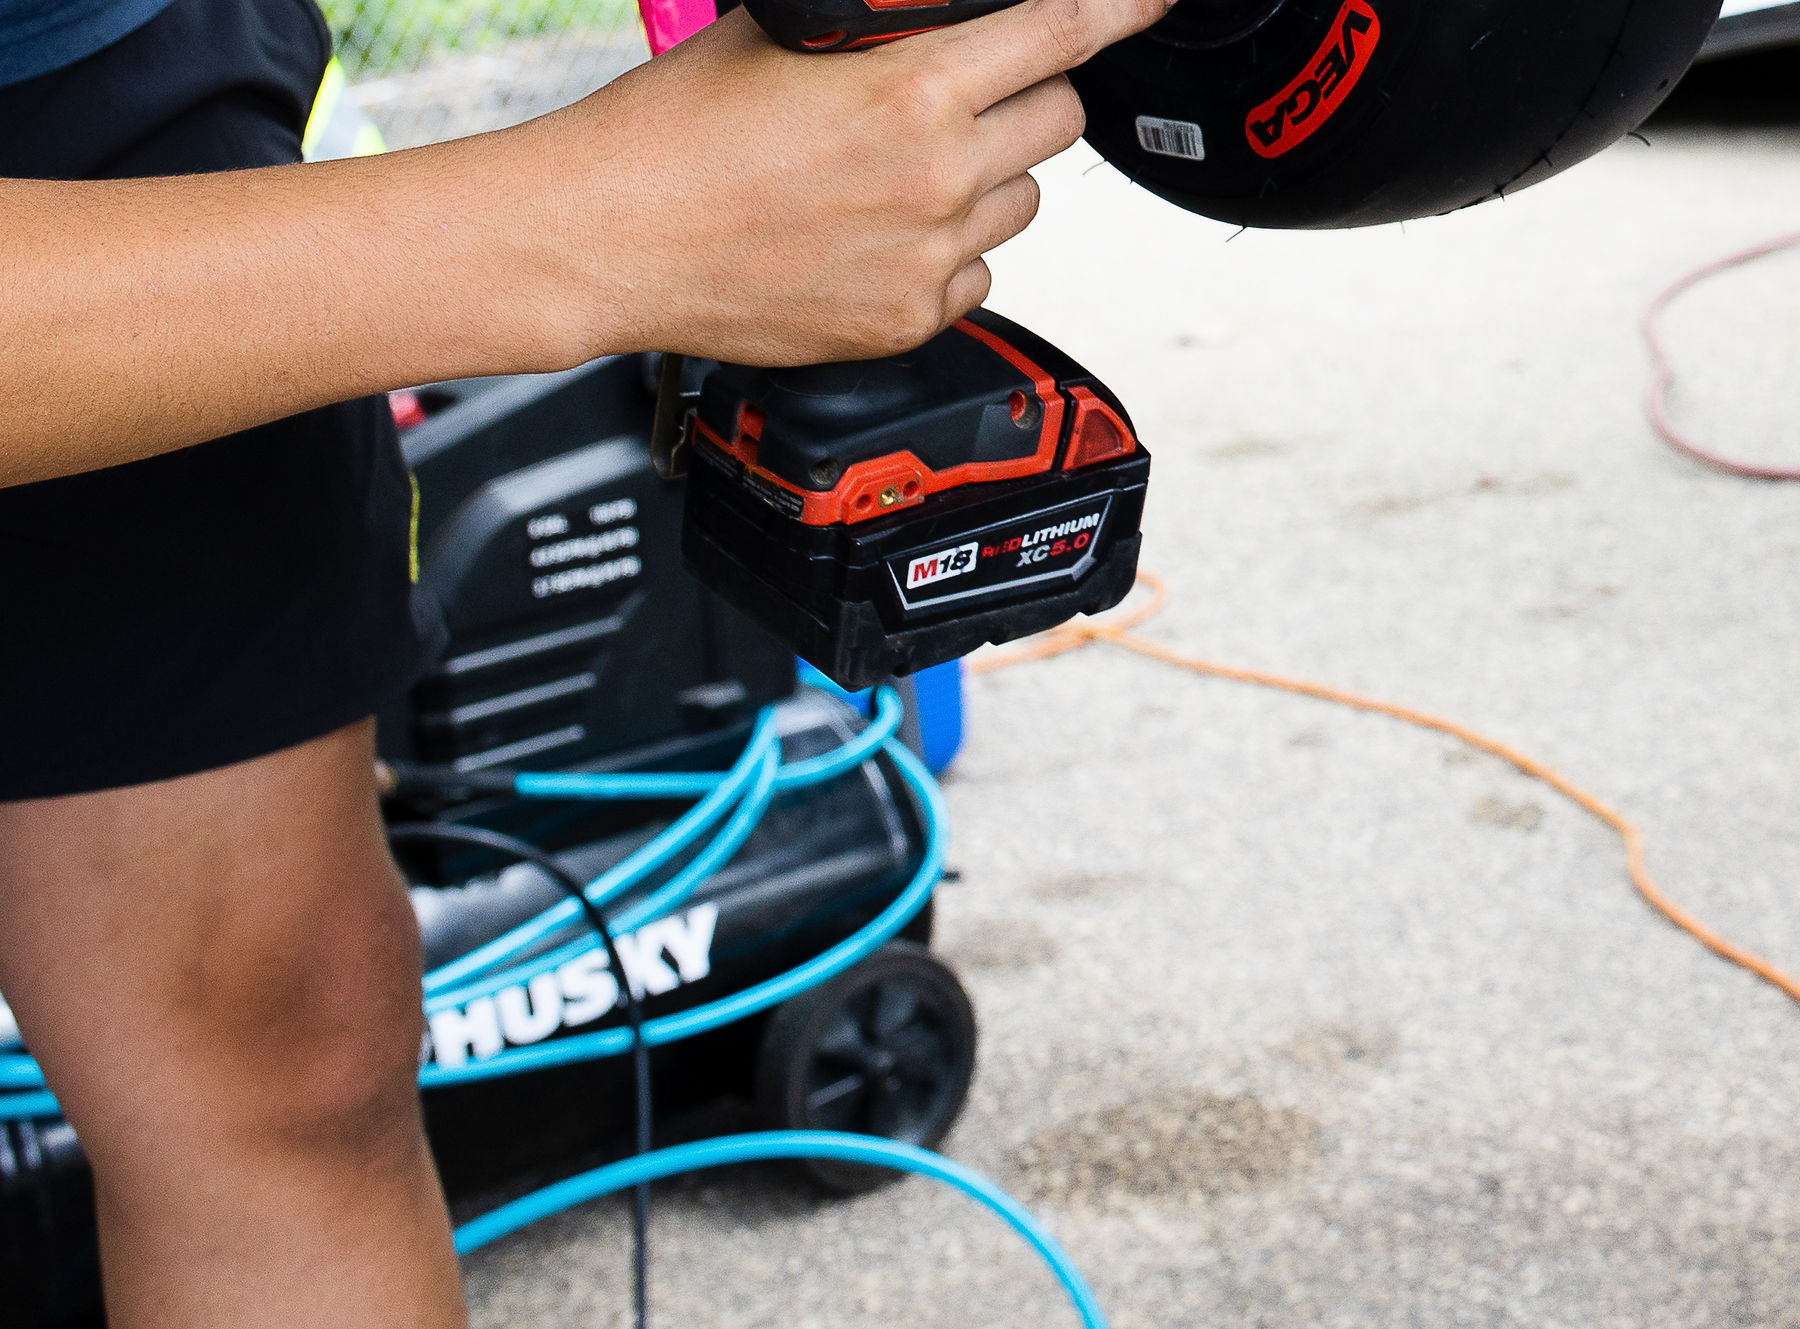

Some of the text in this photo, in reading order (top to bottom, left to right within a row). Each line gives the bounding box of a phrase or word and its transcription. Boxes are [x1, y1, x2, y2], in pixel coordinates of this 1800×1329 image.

[1249, 9, 1373, 148] VEGA
[912, 548, 974, 583] M18
[429, 902, 720, 1071] HUSKY
